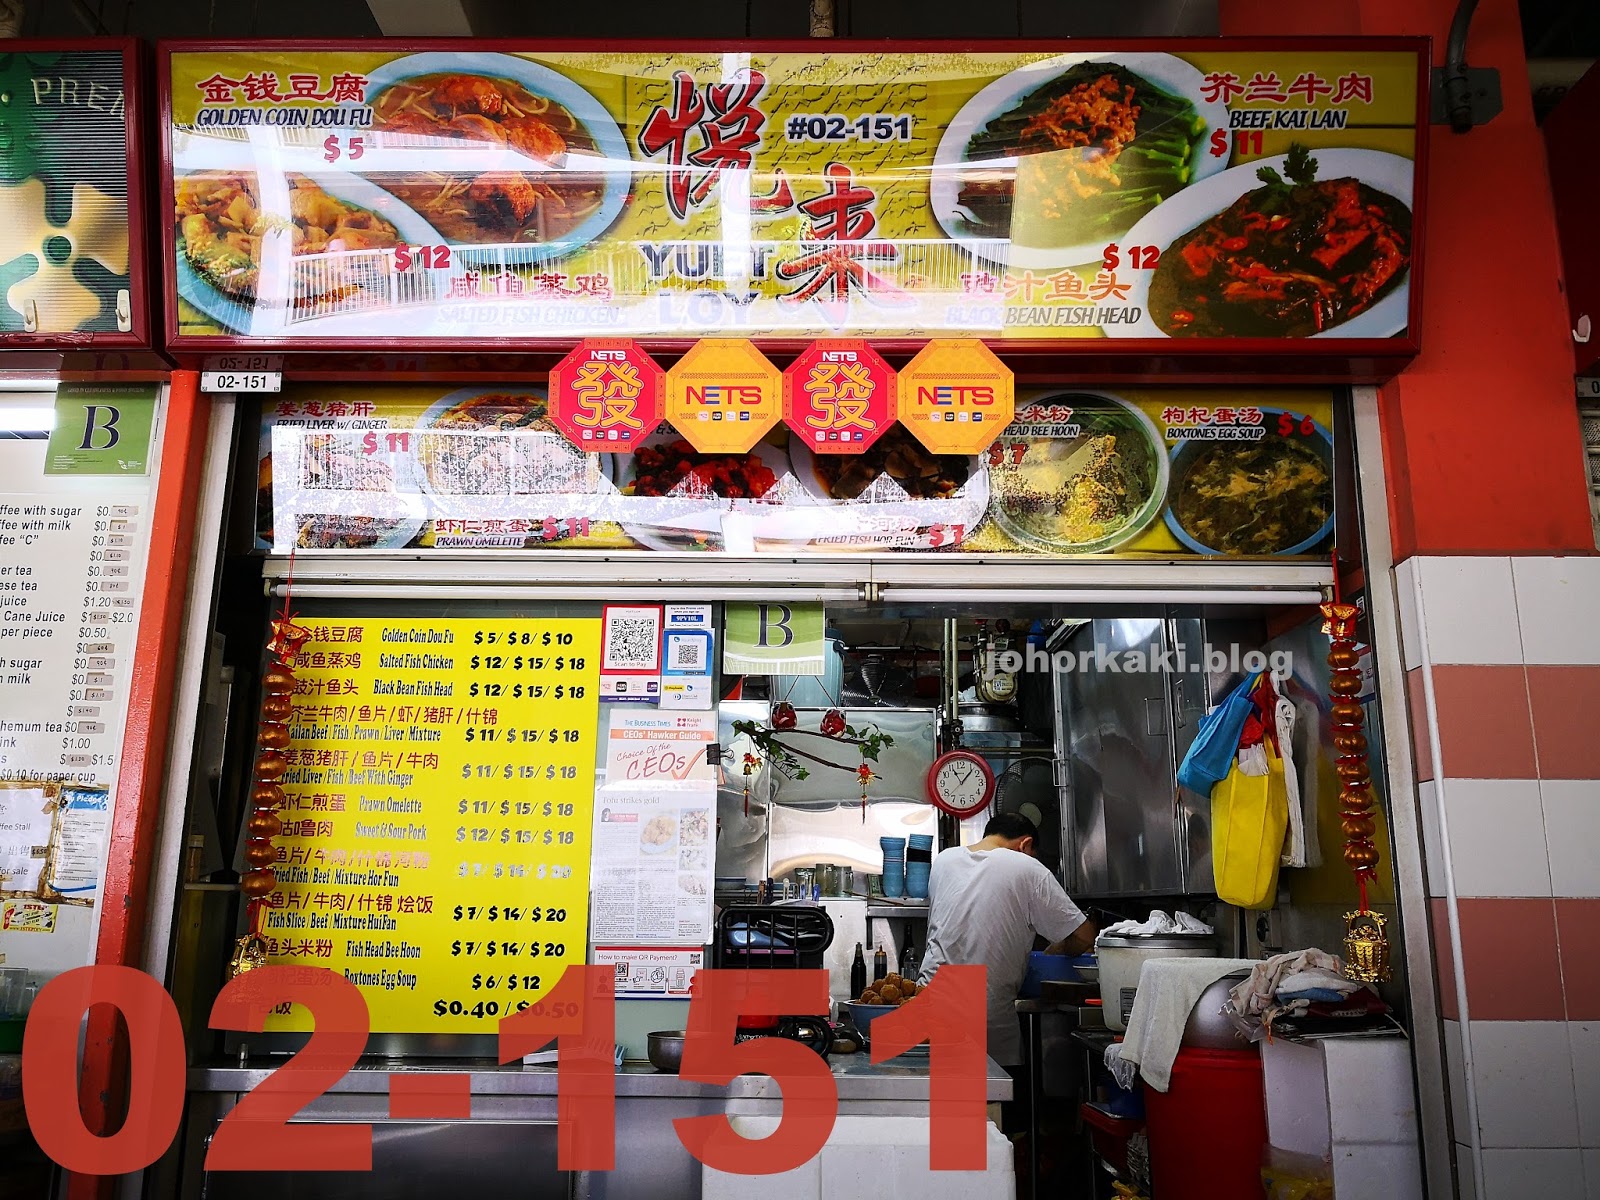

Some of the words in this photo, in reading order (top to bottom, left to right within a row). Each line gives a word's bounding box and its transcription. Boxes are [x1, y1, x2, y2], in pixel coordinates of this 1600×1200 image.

[197, 73, 368, 103] 金钱豆腐
[1200, 73, 1372, 103] 芥兰牛肉
[197, 108, 261, 127] GOLDEN
[264, 109, 308, 127] COIN
[312, 109, 348, 127] DOU
[349, 109, 372, 127] FU
[1229, 110, 1273, 128] BEEF
[1274, 110, 1307, 128] KAI
[1310, 110, 1347, 128] LAN
[787, 117, 909, 140] #02-151
[1005, 307, 1050, 324] BEAN
[1054, 307, 1095, 325] FISH
[1096, 307, 1142, 325] HEAD
[590, 350, 626, 361] NETS
[822, 351, 858, 362] NETS
[217, 375, 267, 389] 02-151
[686, 386, 762, 405] NETS
[917, 386, 995, 405] NETS
[1162, 407, 1263, 424] 枸杞蛋汤
[75, 404, 121, 450] B
[306, 419, 335, 430] LIVER
[352, 419, 388, 430] GINGER
[1003, 425, 1029, 436] HEAD
[1031, 425, 1049, 436] BEE
[1050, 425, 1078, 436] HOON
[1167, 427, 1216, 439] BOXTONES
[1218, 428, 1236, 439] EGG
[1237, 428, 1264, 439] SOUP
[24, 505, 46, 516] with
[50, 506, 82, 518] sugar
[22, 520, 44, 531] with
[48, 520, 72, 531] milk
[436, 536, 474, 547] PRAWN
[475, 536, 524, 547] OMELETTE
[15, 566, 33, 576] tea
[21, 582, 38, 591] tea
[83, 597, 111, 608] $1.20
[4, 610, 32, 622] Cane
[35, 611, 66, 623] Juice
[1, 628, 20, 638] per
[23, 627, 53, 639] piece
[753, 603, 794, 648] B
[382, 628, 407, 643] Golden
[409, 628, 426, 643] Coin
[427, 629, 442, 643] Dou
[443, 630, 454, 643] Fu
[10, 659, 42, 671] sugar
[379, 653, 403, 668] Salted
[405, 653, 421, 669] Fish
[422, 653, 454, 669] Chicken
[8, 673, 31, 684] milk
[374, 679, 395, 694] Black
[396, 680, 415, 695] Bean
[416, 680, 433, 695] Fish
[434, 681, 453, 696] Head
[45, 721, 63, 733] tea
[647, 730, 678, 740] Hawker
[679, 731, 701, 740] Guide
[62, 738, 91, 749] $1.00
[616, 750, 645, 762] Choice
[658, 743, 671, 751] the
[626, 752, 686, 780] CEOs
[30, 769, 44, 780] for
[46, 772, 75, 783] paper
[78, 773, 96, 785] cup
[367, 769, 386, 785] With
[387, 770, 414, 789] Ginger
[359, 796, 385, 812] Prawn
[386, 796, 422, 814] Omelette
[643, 797, 660, 805] gold
[15, 822, 31, 831] Stall
[356, 822, 380, 838] Sweet
[408, 823, 427, 840] Pork
[12, 867, 29, 875] sale
[368, 870, 383, 887] Hor
[384, 870, 399, 887] Fun
[267, 911, 285, 928] Fish
[346, 940, 364, 957] Fish
[365, 941, 384, 958] Head
[385, 941, 399, 958] Bee
[400, 941, 421, 958] Hoon
[381, 969, 396, 990] Egg
[396, 970, 417, 990] Soup
[433, 999, 499, 1019] $0.40
